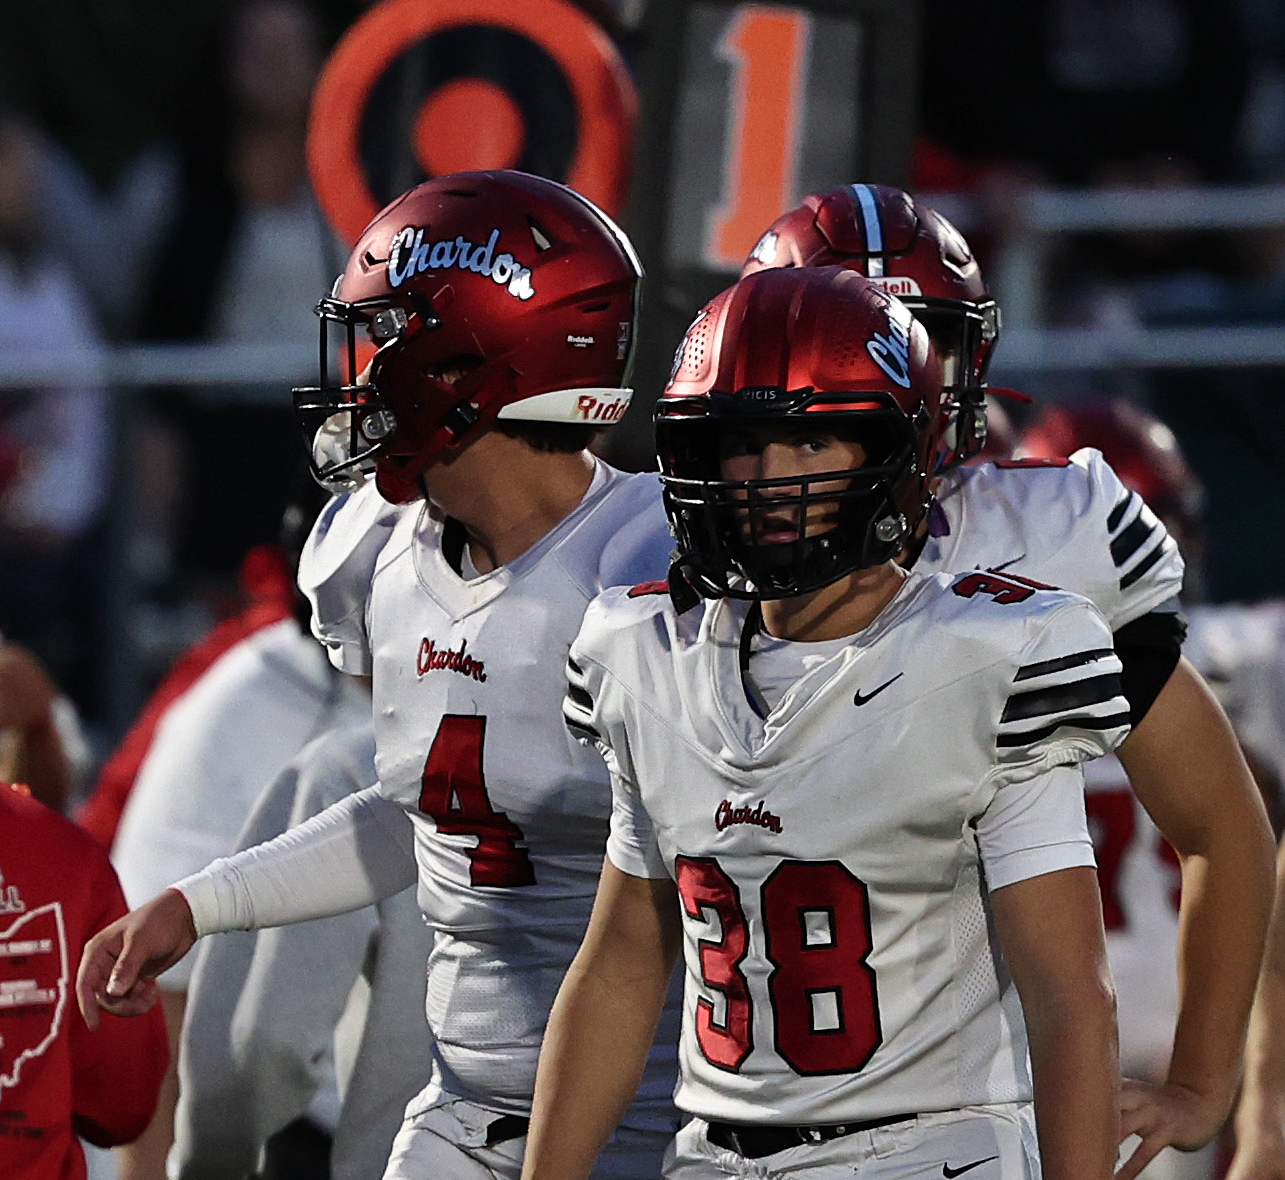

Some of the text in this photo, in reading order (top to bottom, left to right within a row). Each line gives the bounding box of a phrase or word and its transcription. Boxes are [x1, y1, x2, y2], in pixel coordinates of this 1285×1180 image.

[707, 4, 809, 270] 1
[387, 226, 536, 301] Chardon
[415, 636, 487, 684] Chardon
[417, 713, 538, 888] 4
[714, 799, 784, 834] Chardon
[674, 853, 884, 1078] 38
